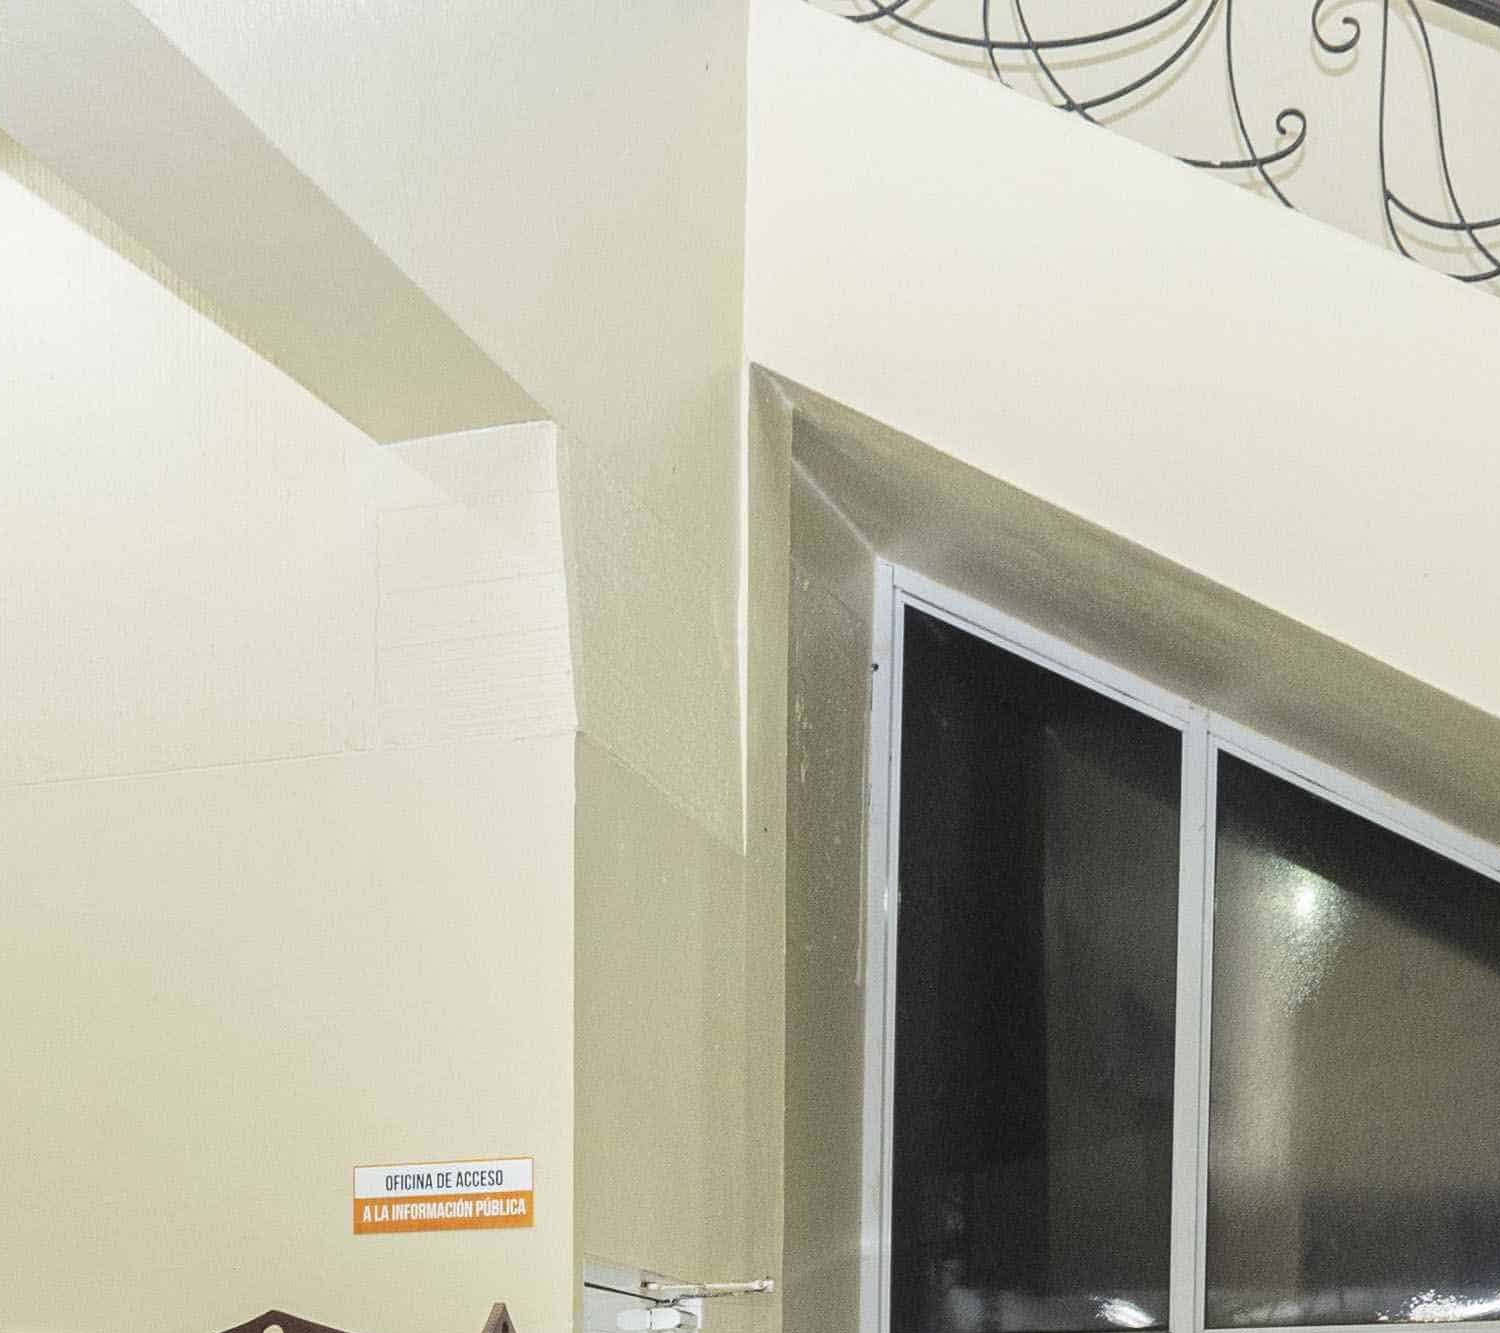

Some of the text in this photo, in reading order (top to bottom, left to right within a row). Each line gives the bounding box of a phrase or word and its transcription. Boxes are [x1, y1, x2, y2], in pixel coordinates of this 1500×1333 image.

[385, 1169, 503, 1191] OFICINA DE ACCESO
[362, 1195, 527, 1223] A LA INFORMACIÓN PÚBLICA
